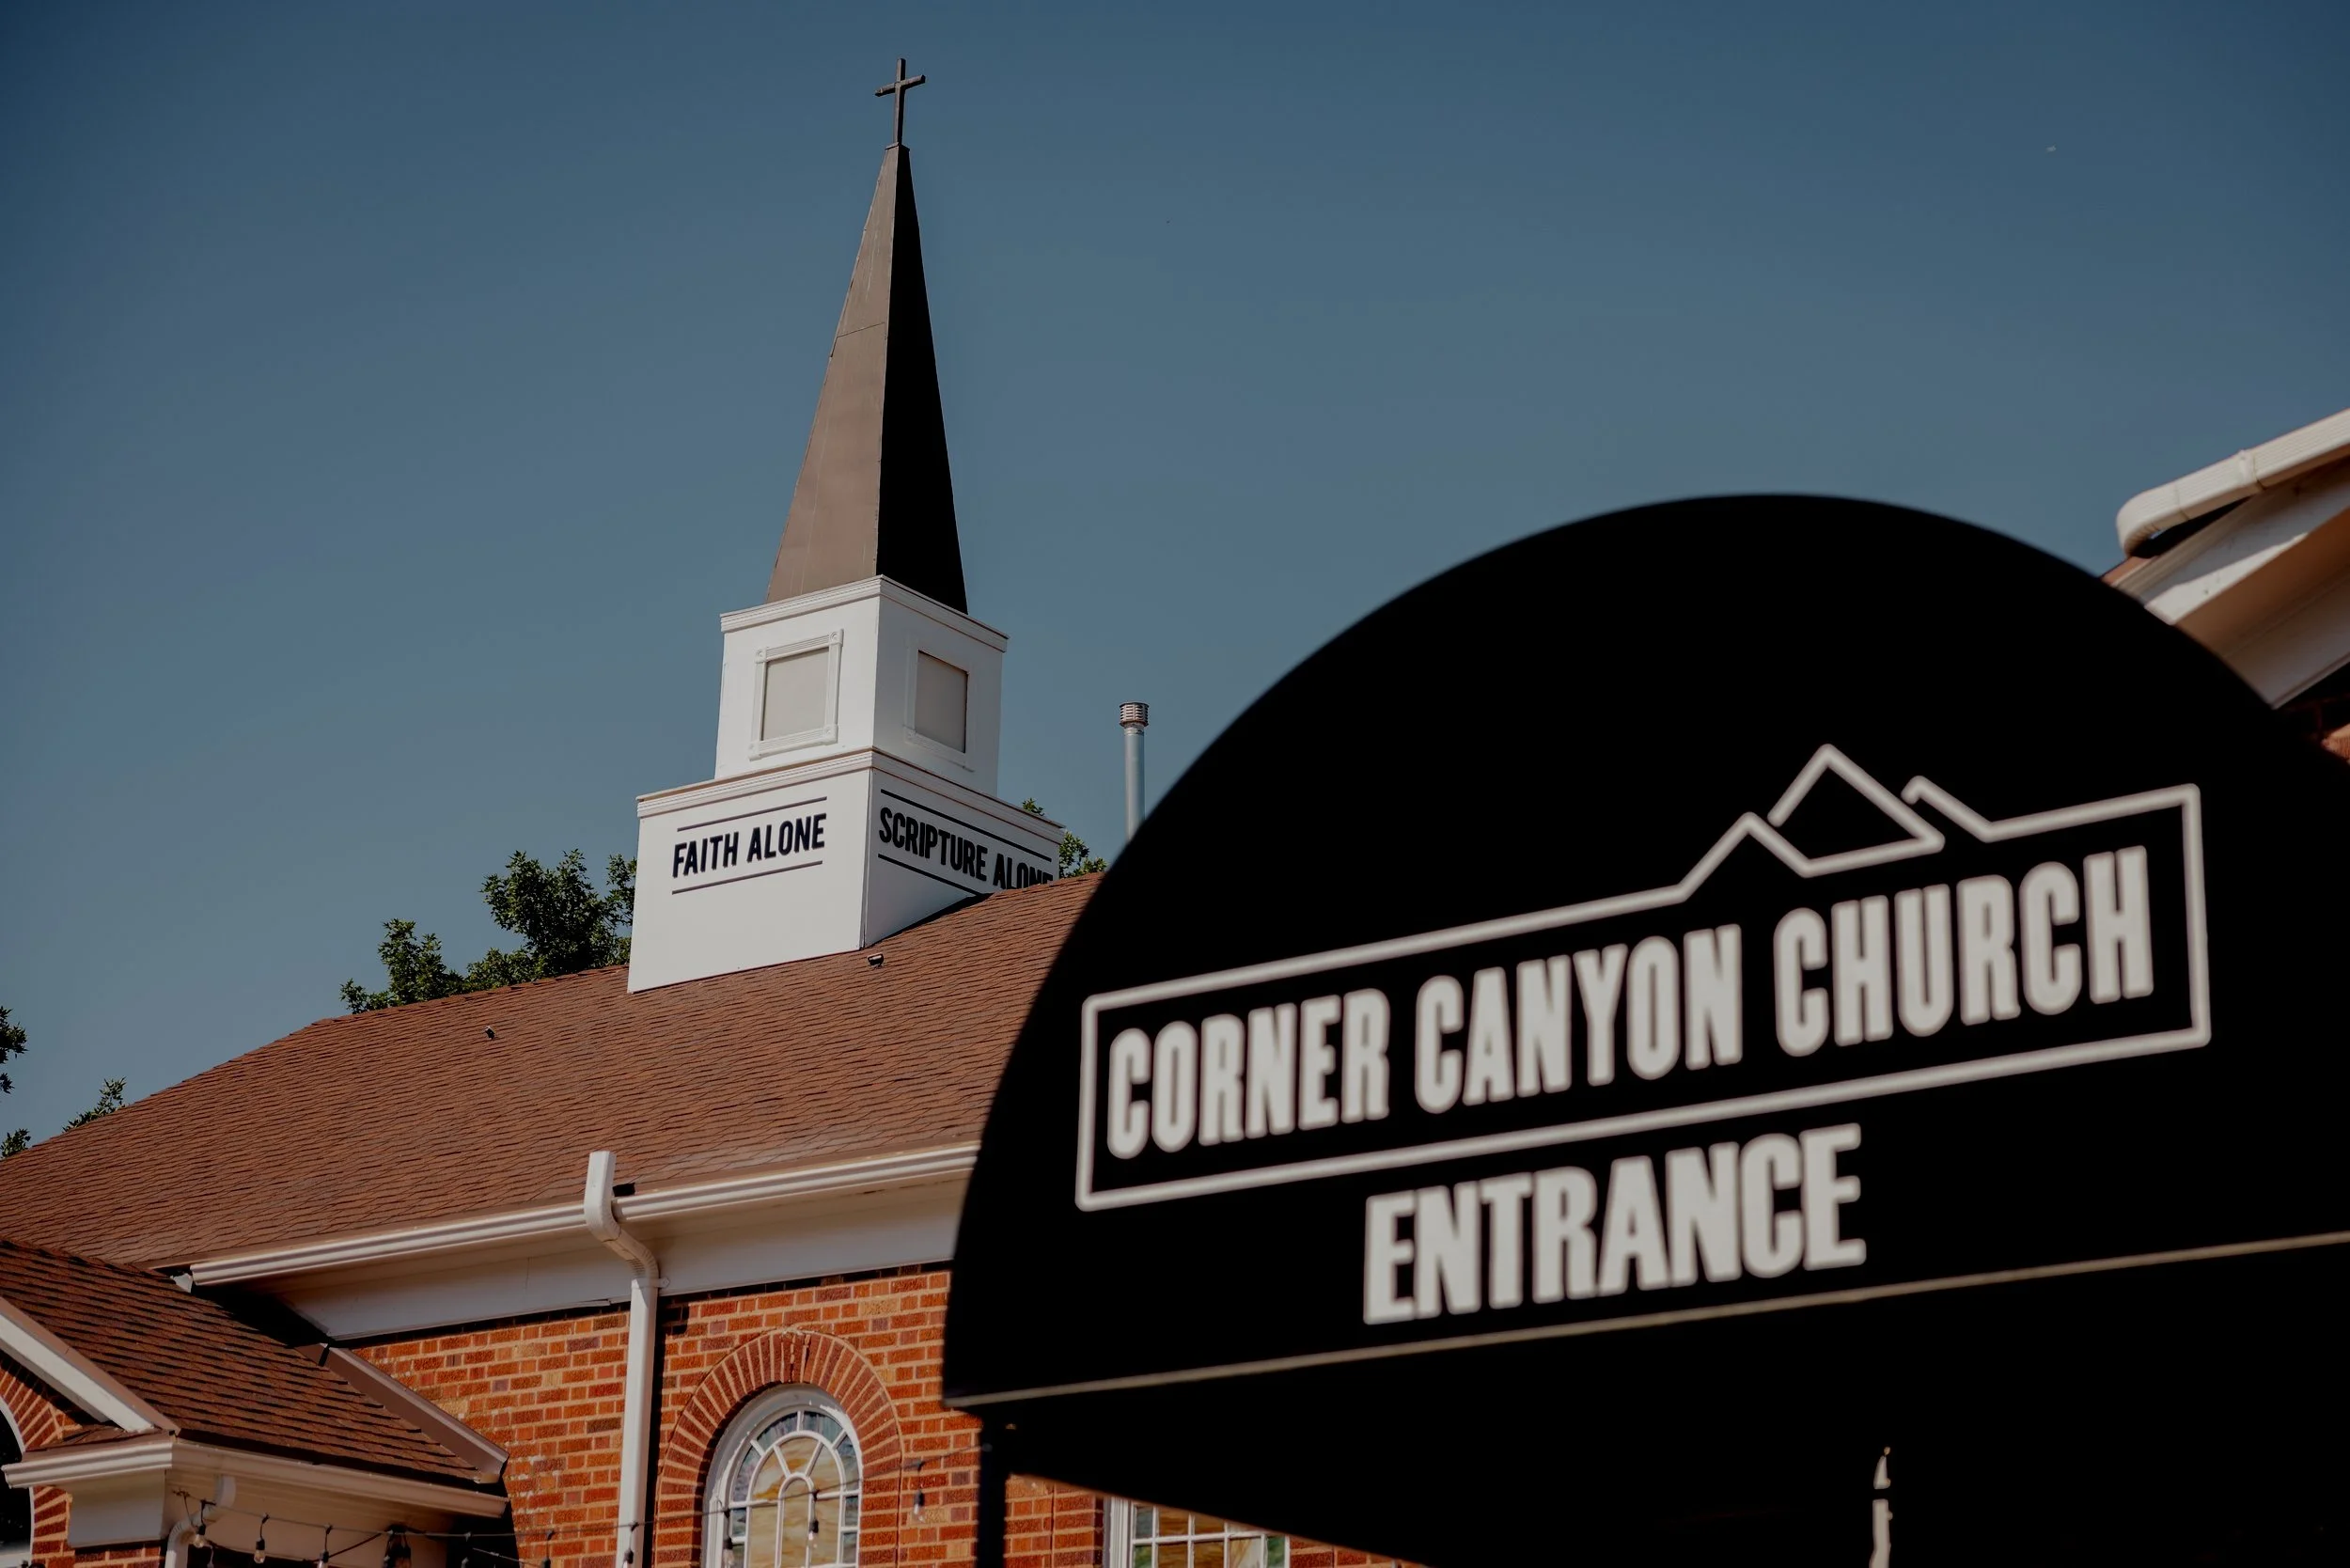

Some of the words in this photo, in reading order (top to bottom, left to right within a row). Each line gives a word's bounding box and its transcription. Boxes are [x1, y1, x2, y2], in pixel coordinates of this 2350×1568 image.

[672, 831, 740, 878] FAITH
[746, 813, 826, 863] ALONE
[879, 807, 987, 882] SCRIPTURE
[1107, 988, 1390, 1161] CORNER
[1415, 922, 1745, 1115] CANYON
[1773, 845, 2154, 1058] CHURCH
[1363, 1123, 1867, 1325] ENTRANCE
